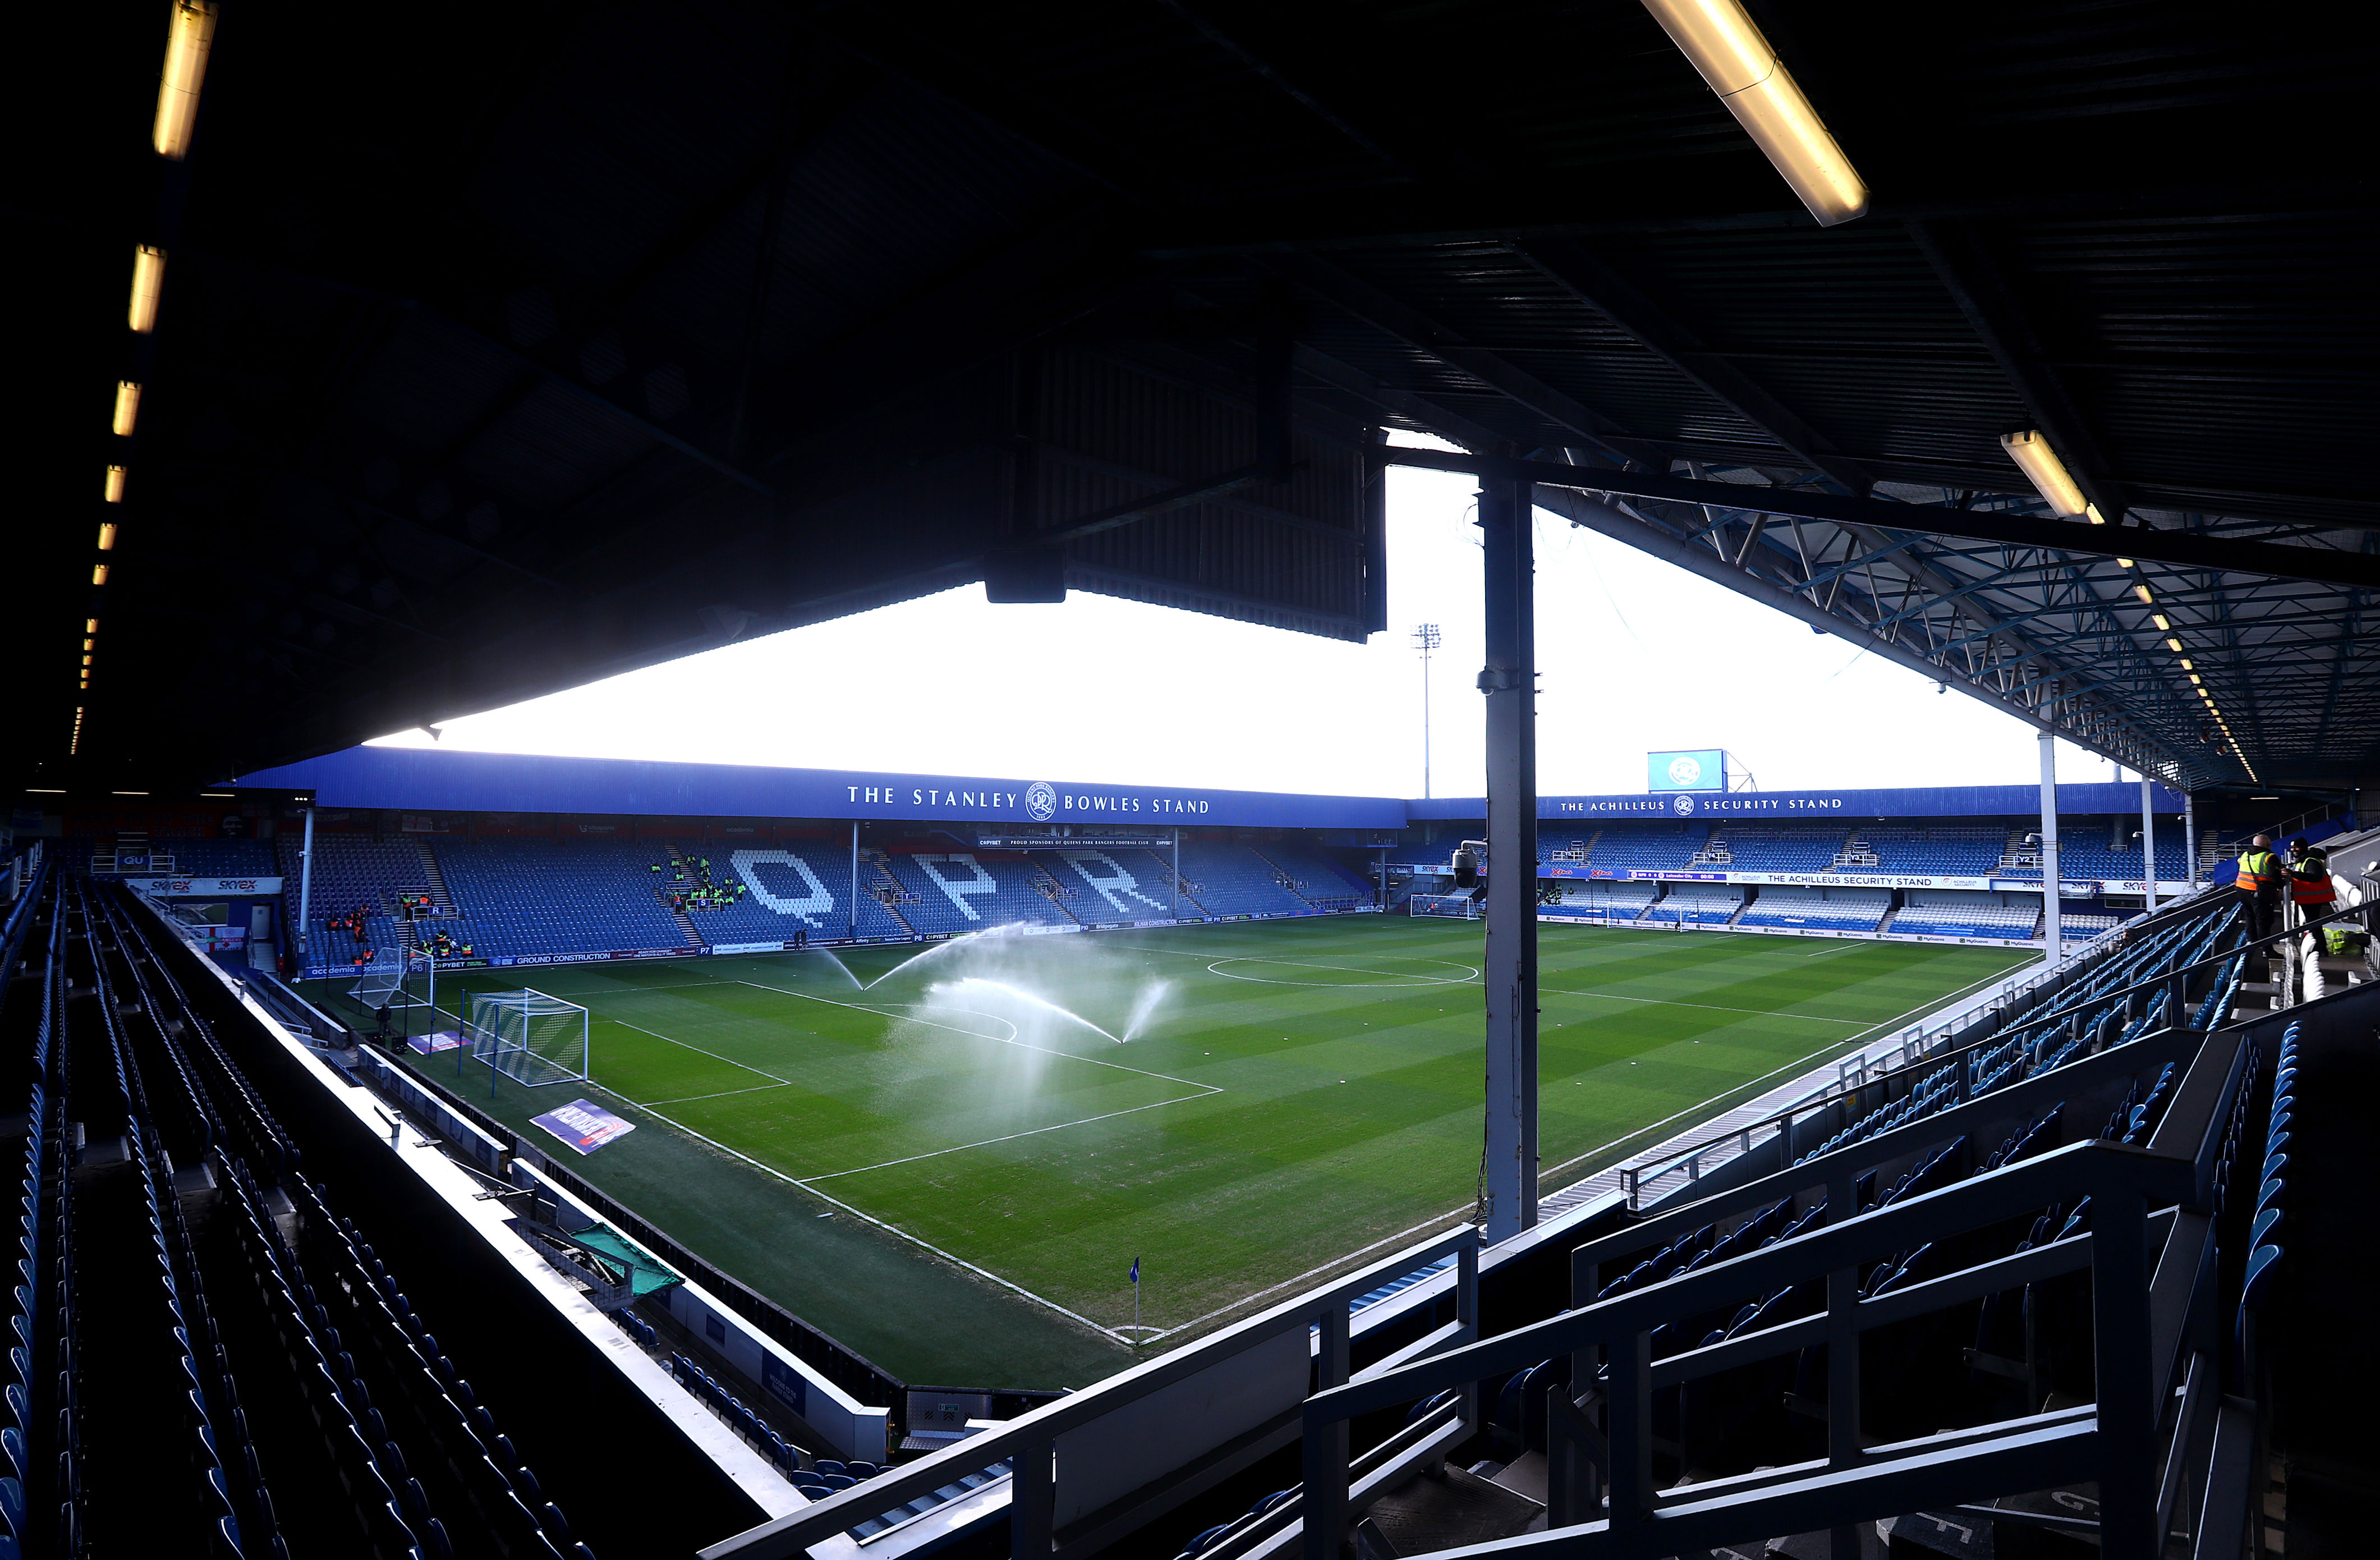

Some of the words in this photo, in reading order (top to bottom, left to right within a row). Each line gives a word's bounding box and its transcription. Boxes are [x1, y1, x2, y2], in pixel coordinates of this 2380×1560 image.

[847, 786, 893, 804] THE
[913, 789, 1016, 808] STANLEY
[1064, 795, 1140, 812] BOWLES
[1152, 799, 1209, 814] STAND
[1561, 803, 1583, 811] THE
[1591, 801, 1665, 810] ACHILLEUS
[1704, 800, 1779, 810] SECURITY
[1789, 799, 1842, 809] STAND
[153, 827, 206, 837] TRACK
[123, 856, 144, 865] QU
[517, 956, 551, 965] GROUND
[553, 953, 611, 963] CONSTRUCTION
[311, 966, 355, 975] academia
